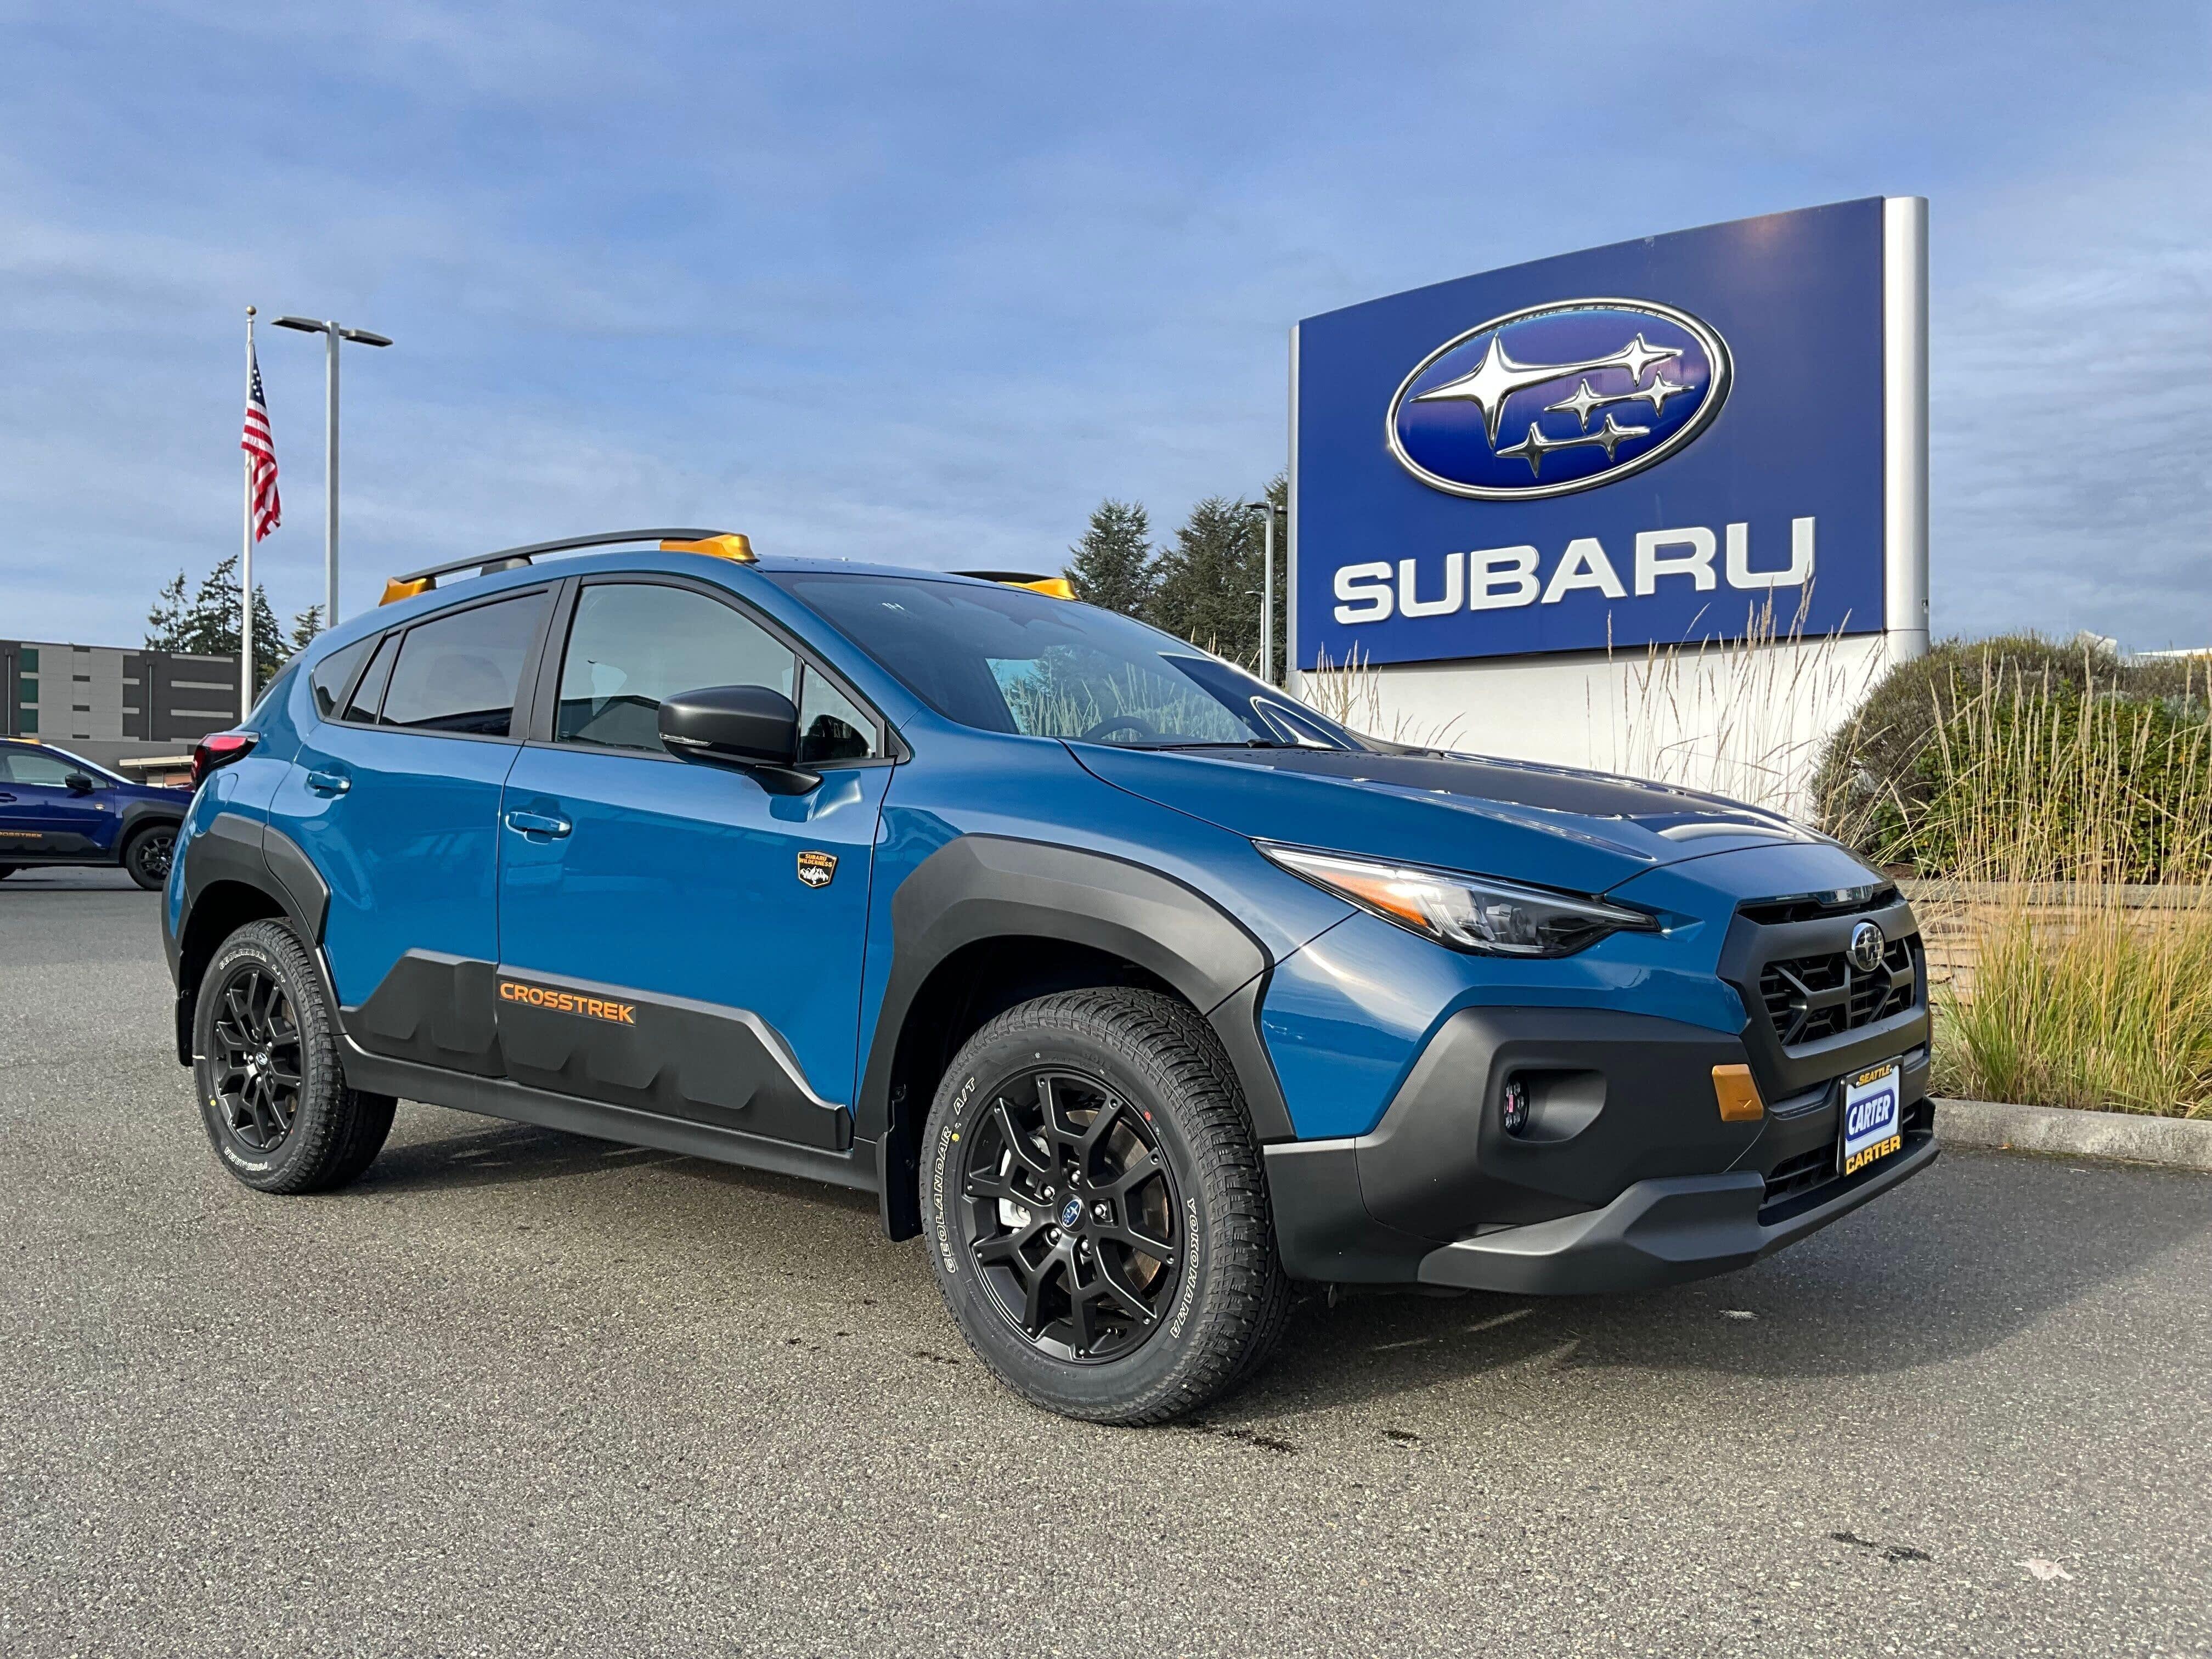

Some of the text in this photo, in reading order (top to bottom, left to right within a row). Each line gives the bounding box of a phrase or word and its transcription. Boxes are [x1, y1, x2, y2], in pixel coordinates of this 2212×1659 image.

[1334, 516, 1815, 625] SUBARU
[799, 857, 833, 867] WILDERNESS
[500, 983, 634, 1023] CROSSTREK
[1859, 1064, 1891, 1085] SEATTLE
[1848, 1094, 1891, 1136] CARTER
[934, 1077, 974, 1273] GEOLANDAR A/T
[1846, 1135, 1901, 1175] CARTER
[1170, 1197, 1199, 1339] YOKOHAMA
